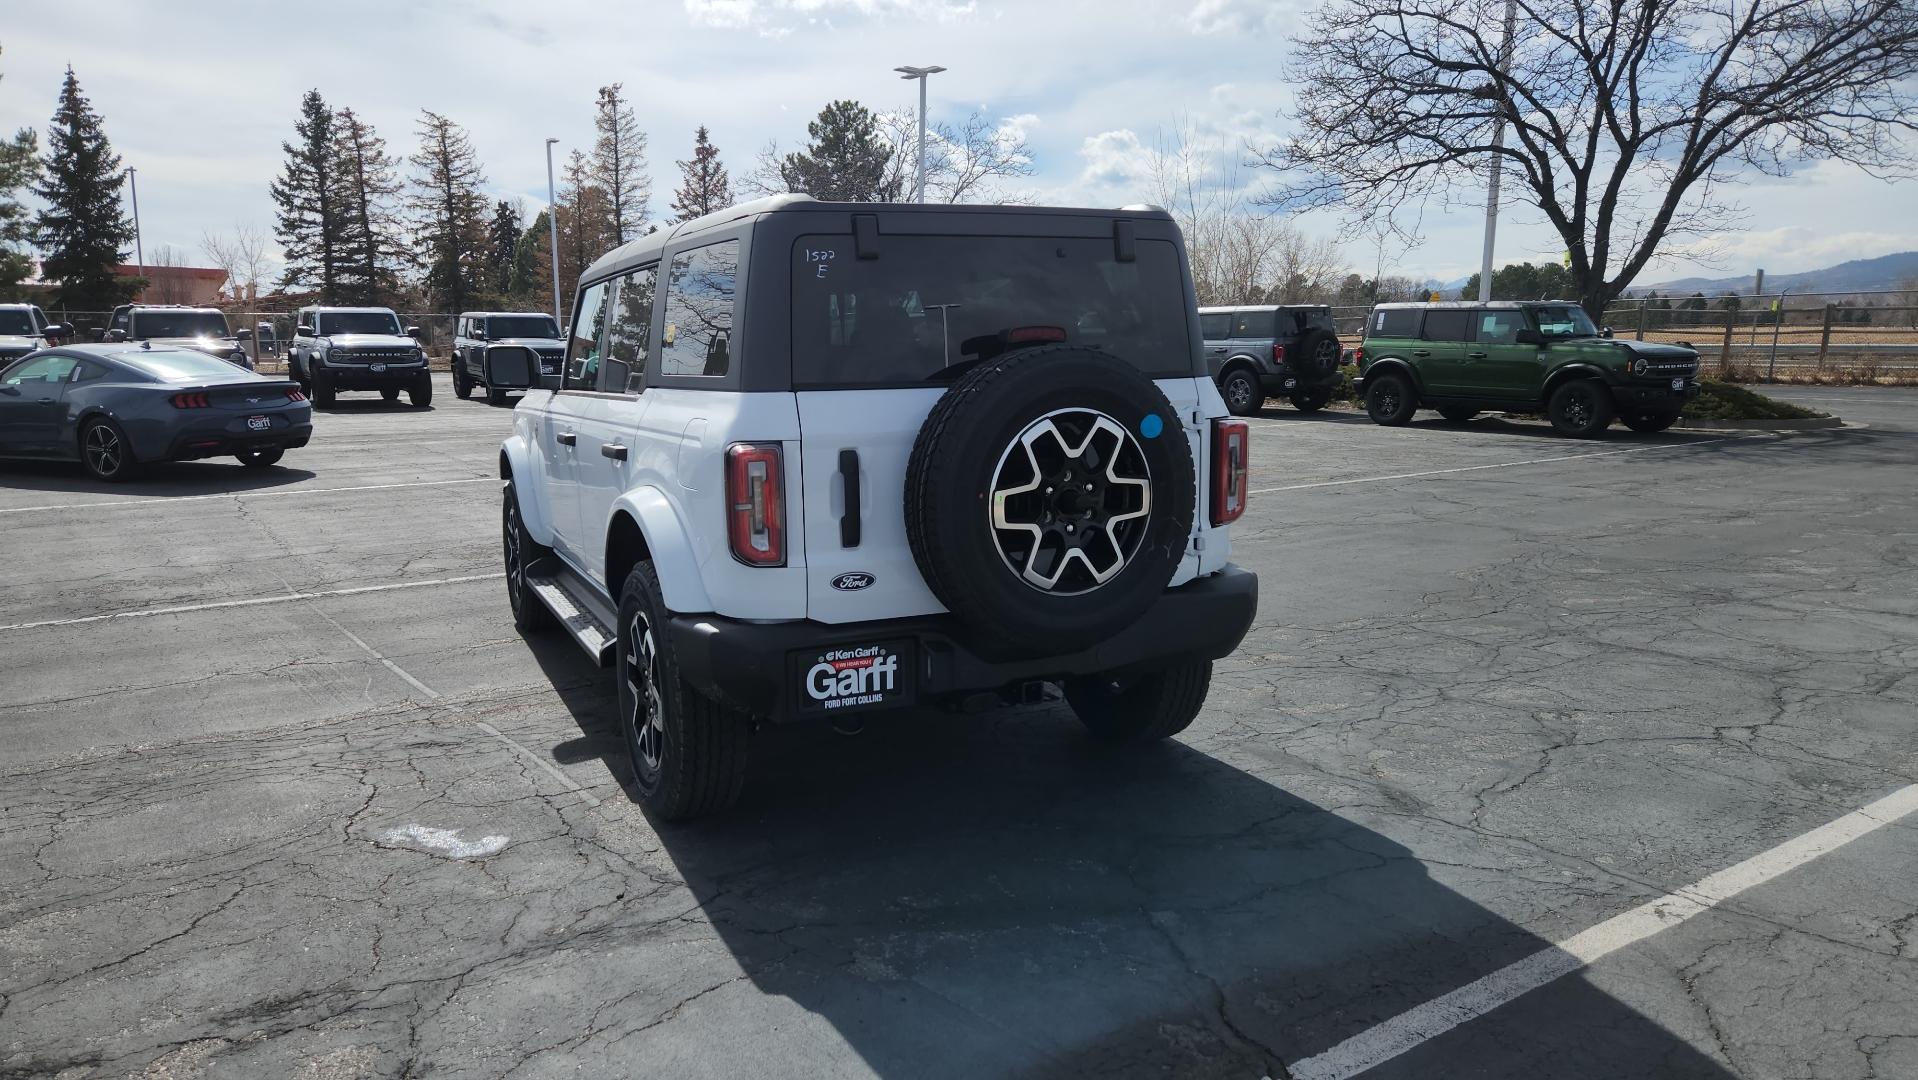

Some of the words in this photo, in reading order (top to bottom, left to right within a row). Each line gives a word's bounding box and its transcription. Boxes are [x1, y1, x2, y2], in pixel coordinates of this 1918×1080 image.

[806, 249, 835, 262] 1522
[816, 263, 828, 279] E
[247, 416, 271, 429] Garff
[840, 575, 868, 588] Ford
[835, 650, 854, 660] Ken
[854, 646, 879, 658] Garff
[806, 654, 898, 700] Garff
[824, 699, 841, 709] FORD
[841, 696, 857, 707] FORT
[857, 693, 883, 705] COLLINS
